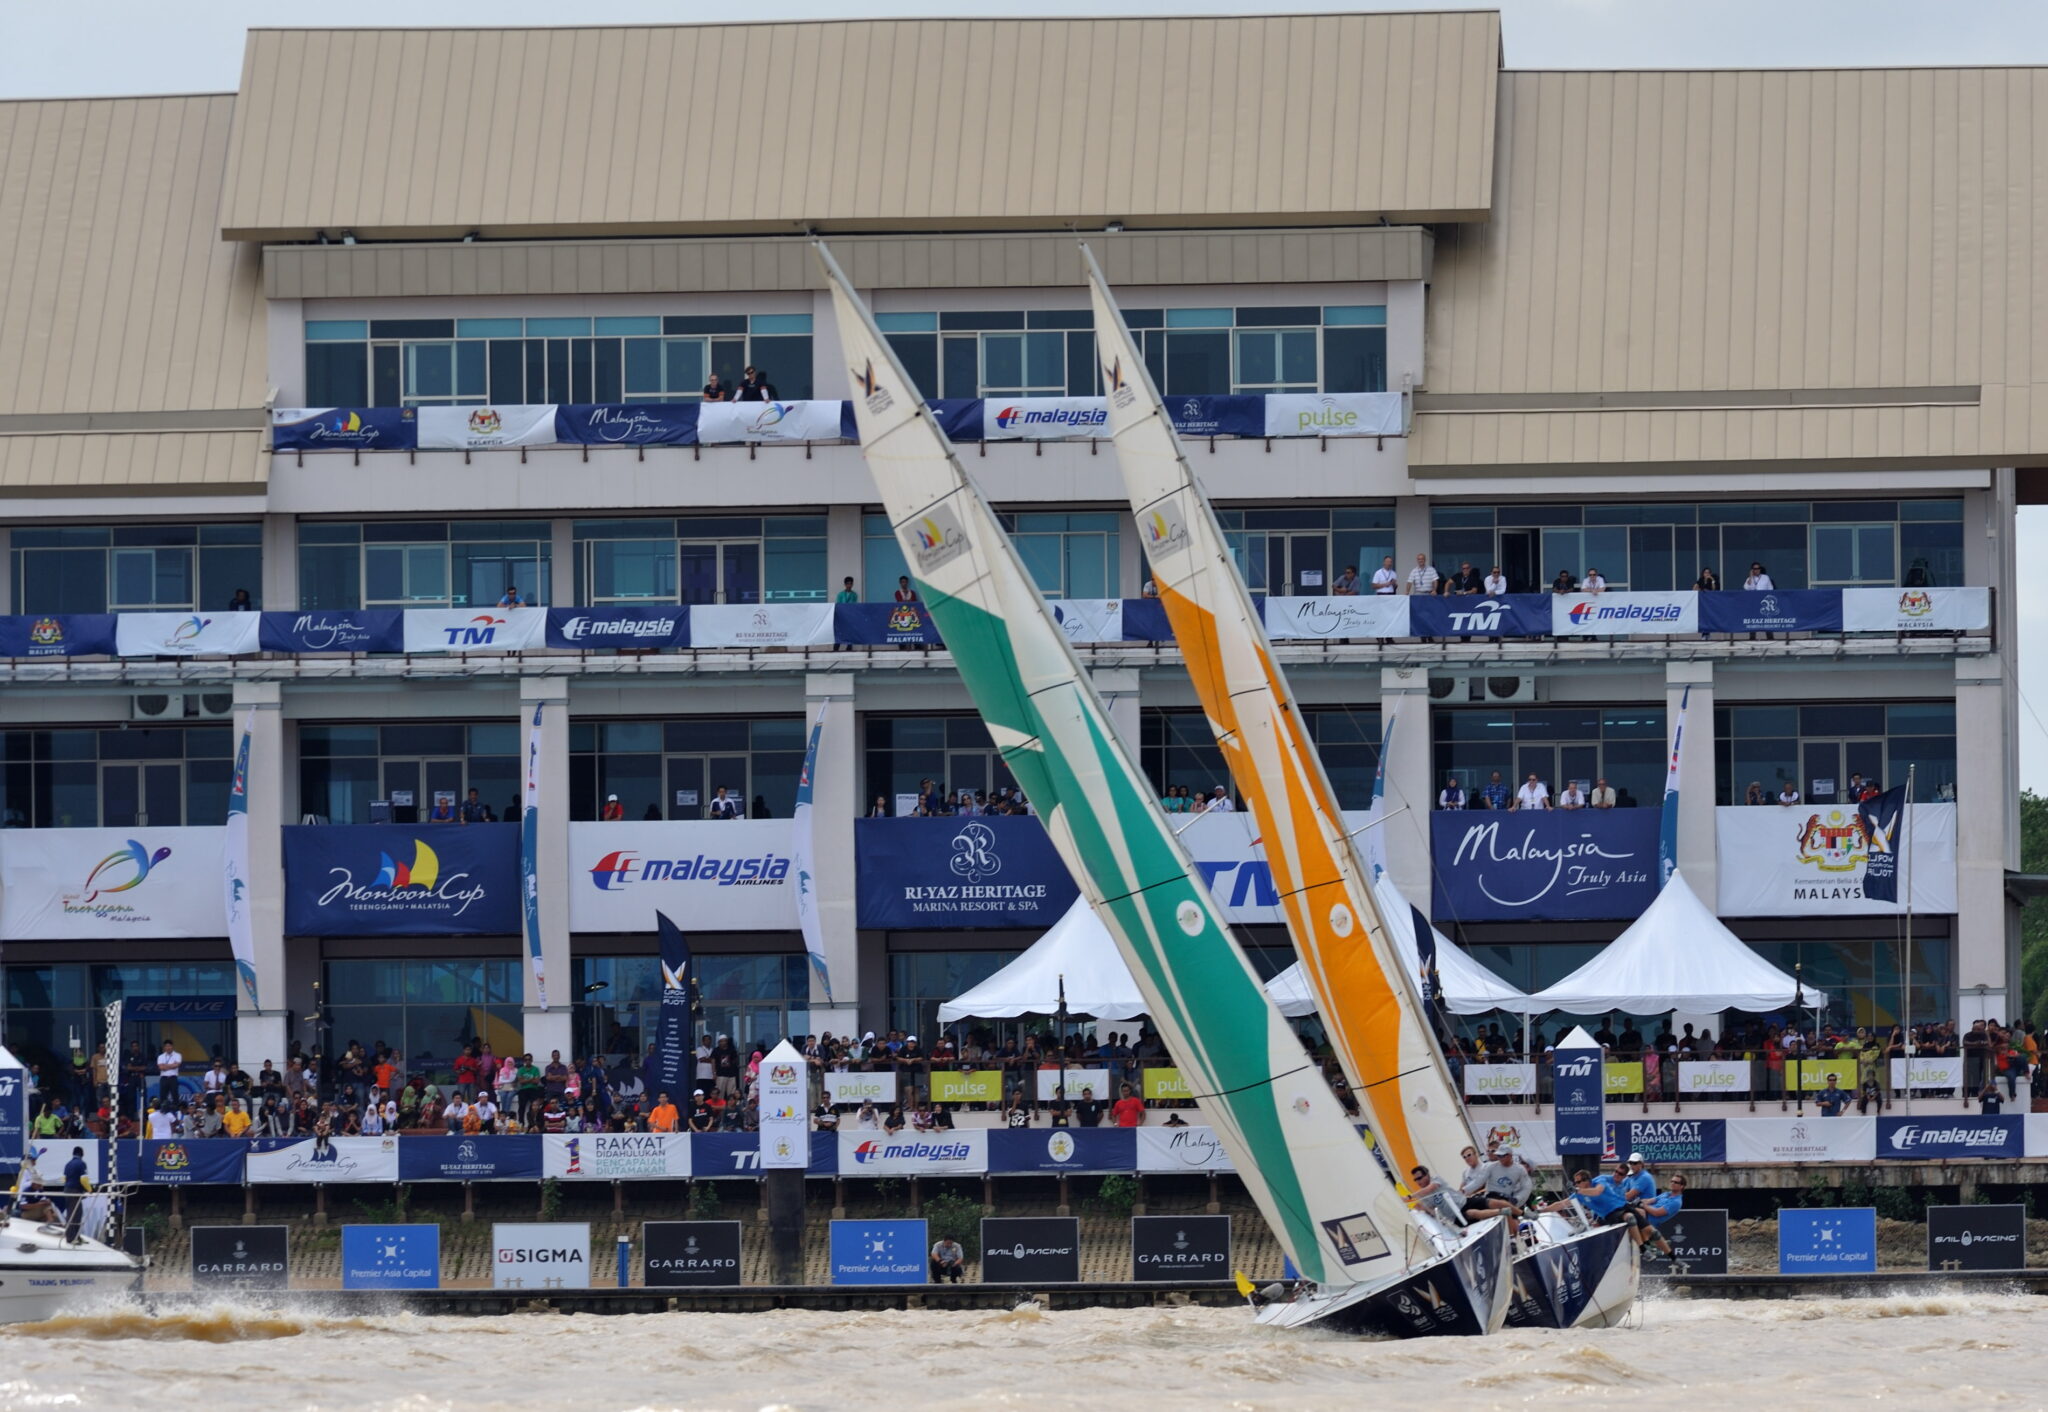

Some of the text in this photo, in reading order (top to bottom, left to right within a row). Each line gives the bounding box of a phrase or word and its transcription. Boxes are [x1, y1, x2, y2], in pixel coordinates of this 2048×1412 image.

[1024, 407, 1108, 426] malaysia
[1298, 407, 1358, 429] pulse
[589, 408, 661, 441] Malaysia
[357, 423, 380, 445] Cup
[1297, 601, 1369, 635] Malaysia
[1597, 603, 1681, 622] malaysia
[590, 617, 676, 637] malaysia
[1448, 612, 1501, 631] TM
[292, 615, 365, 649] Malaysia
[444, 627, 496, 645] TM
[641, 853, 791, 886] malaysia
[1453, 821, 1635, 906] Malaysia
[1567, 865, 1648, 887] Truly Asia
[318, 867, 438, 907] Monsoon
[436, 873, 486, 917] Cup
[904, 884, 1047, 900] RI-YAZ HERITAGE
[1794, 887, 1862, 900] MALAYS
[350, 902, 451, 911] TERENGGANU MALAYSIA
[913, 901, 1039, 912] MARINA RESORT & SPA
[136, 1001, 225, 1012] REVIVE
[1557, 1064, 1592, 1077] TM
[1692, 1069, 1735, 1087] pulse
[1157, 1077, 1190, 1094] puls
[1478, 1074, 1521, 1092] pulse
[1606, 1073, 1628, 1087] lse
[839, 1082, 881, 1099] pulse
[944, 1080, 987, 1098] pulse
[1010, 1115, 1026, 1126] 52
[1631, 1122, 1701, 1135] RAKYAT
[1920, 1126, 2009, 1146] malaysia
[596, 1136, 666, 1150] RAKYAT
[1631, 1135, 1701, 1144] DIDAHULUKAN
[596, 1150, 666, 1158] DIDAHULUKAN
[883, 1142, 971, 1161] malaysia
[1170, 1130, 1222, 1166] Malays
[1631, 1143, 1701, 1152] PENCAPAIAN
[596, 1158, 667, 1167] PENCAPAIAN
[730, 1150, 761, 1170] T
[1643, 1152, 1701, 1161] UTAMAKAN
[335, 1156, 358, 1174] Cup
[596, 1166, 667, 1175] DIUTAMAKAN
[1973, 1234, 2016, 1243] RACING
[515, 1249, 584, 1263] SIGMA
[987, 1247, 1070, 1256] SAIL RACING
[1138, 1253, 1226, 1263] GARRARD
[1674, 1247, 1723, 1256] RARD
[1786, 1251, 1868, 1263] Premier Asia Capital
[198, 1263, 284, 1273] GARRARD
[649, 1258, 737, 1268] GARRARD
[838, 1263, 920, 1274] Premier Asia Capital
[351, 1268, 433, 1279] Premier Asia Capital
